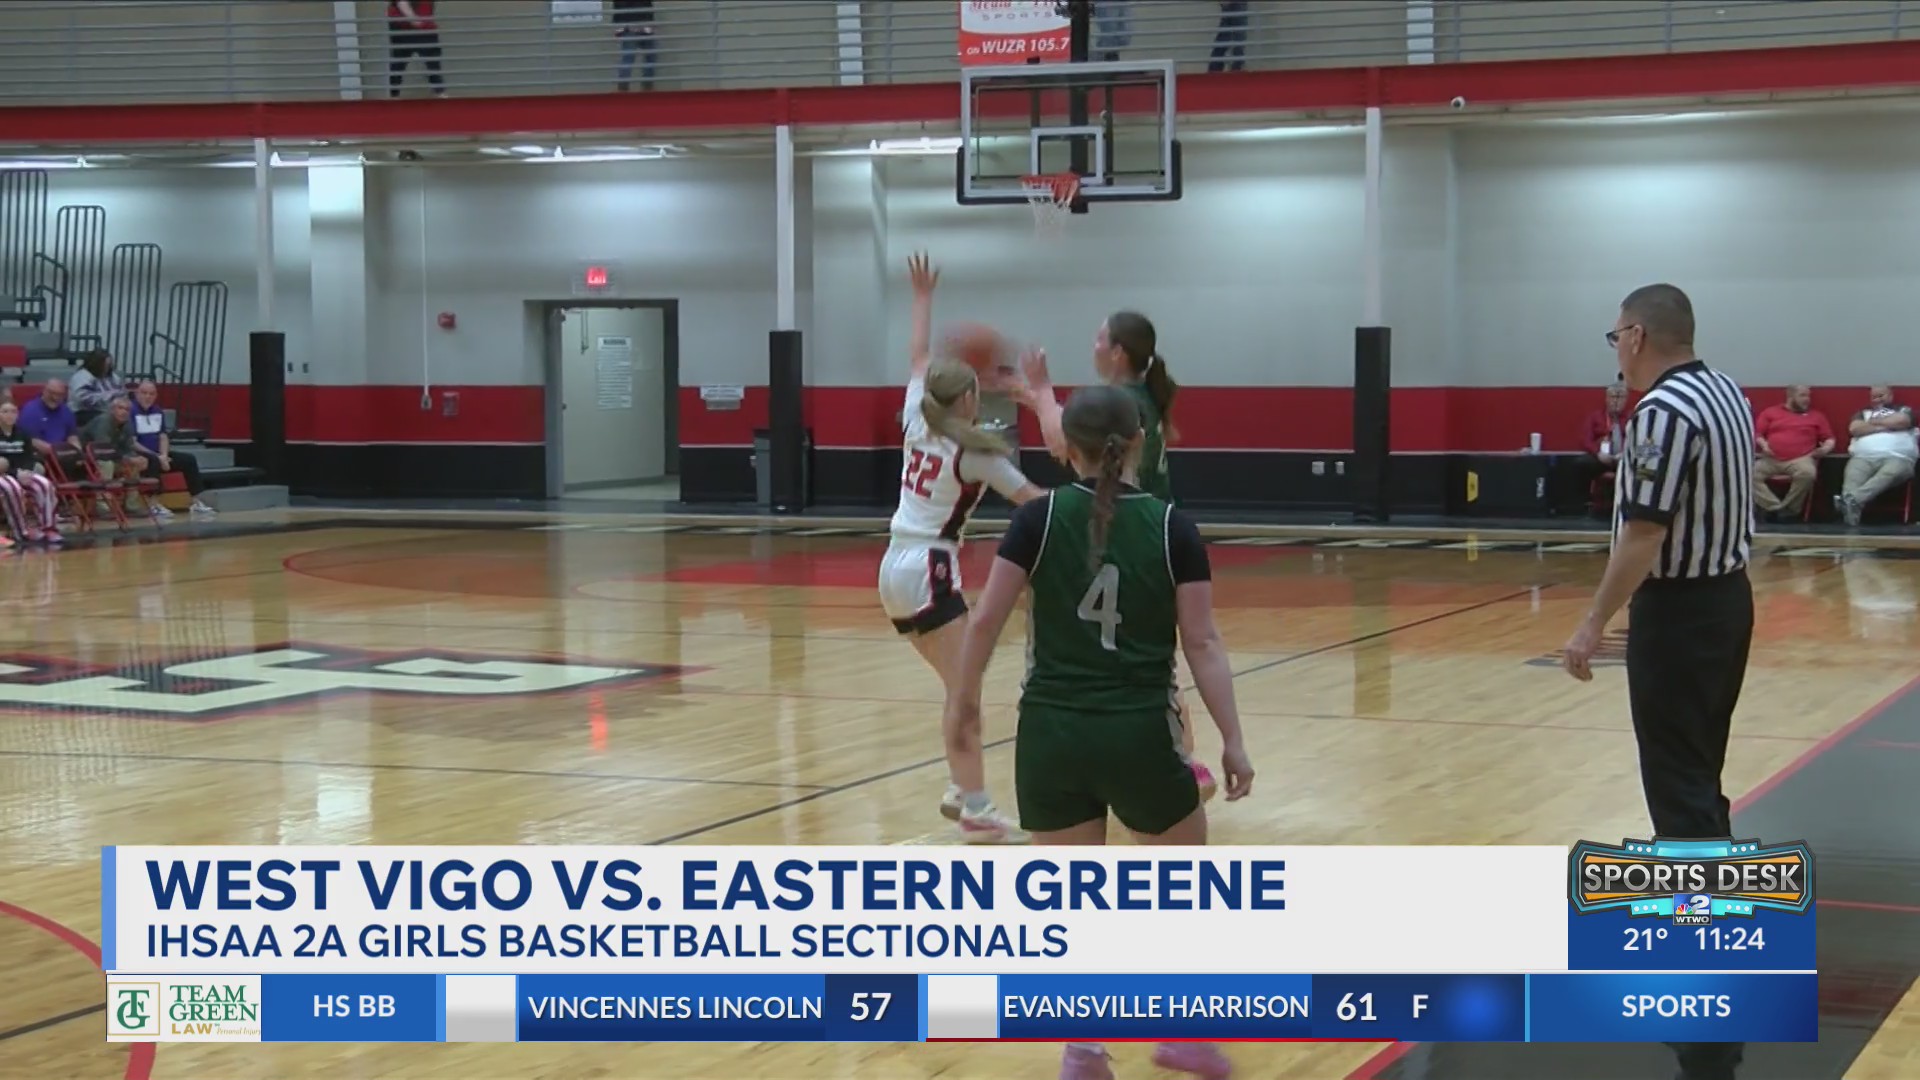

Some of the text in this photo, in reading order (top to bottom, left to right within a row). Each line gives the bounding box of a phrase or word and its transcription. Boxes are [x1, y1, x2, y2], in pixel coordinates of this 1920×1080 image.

[982, 11, 1052, 21] SPORTS
[982, 40, 1026, 54] WUZR
[1031, 37, 1070, 52] 105.7
[906, 450, 944, 499] 22
[1077, 563, 1122, 650] 4
